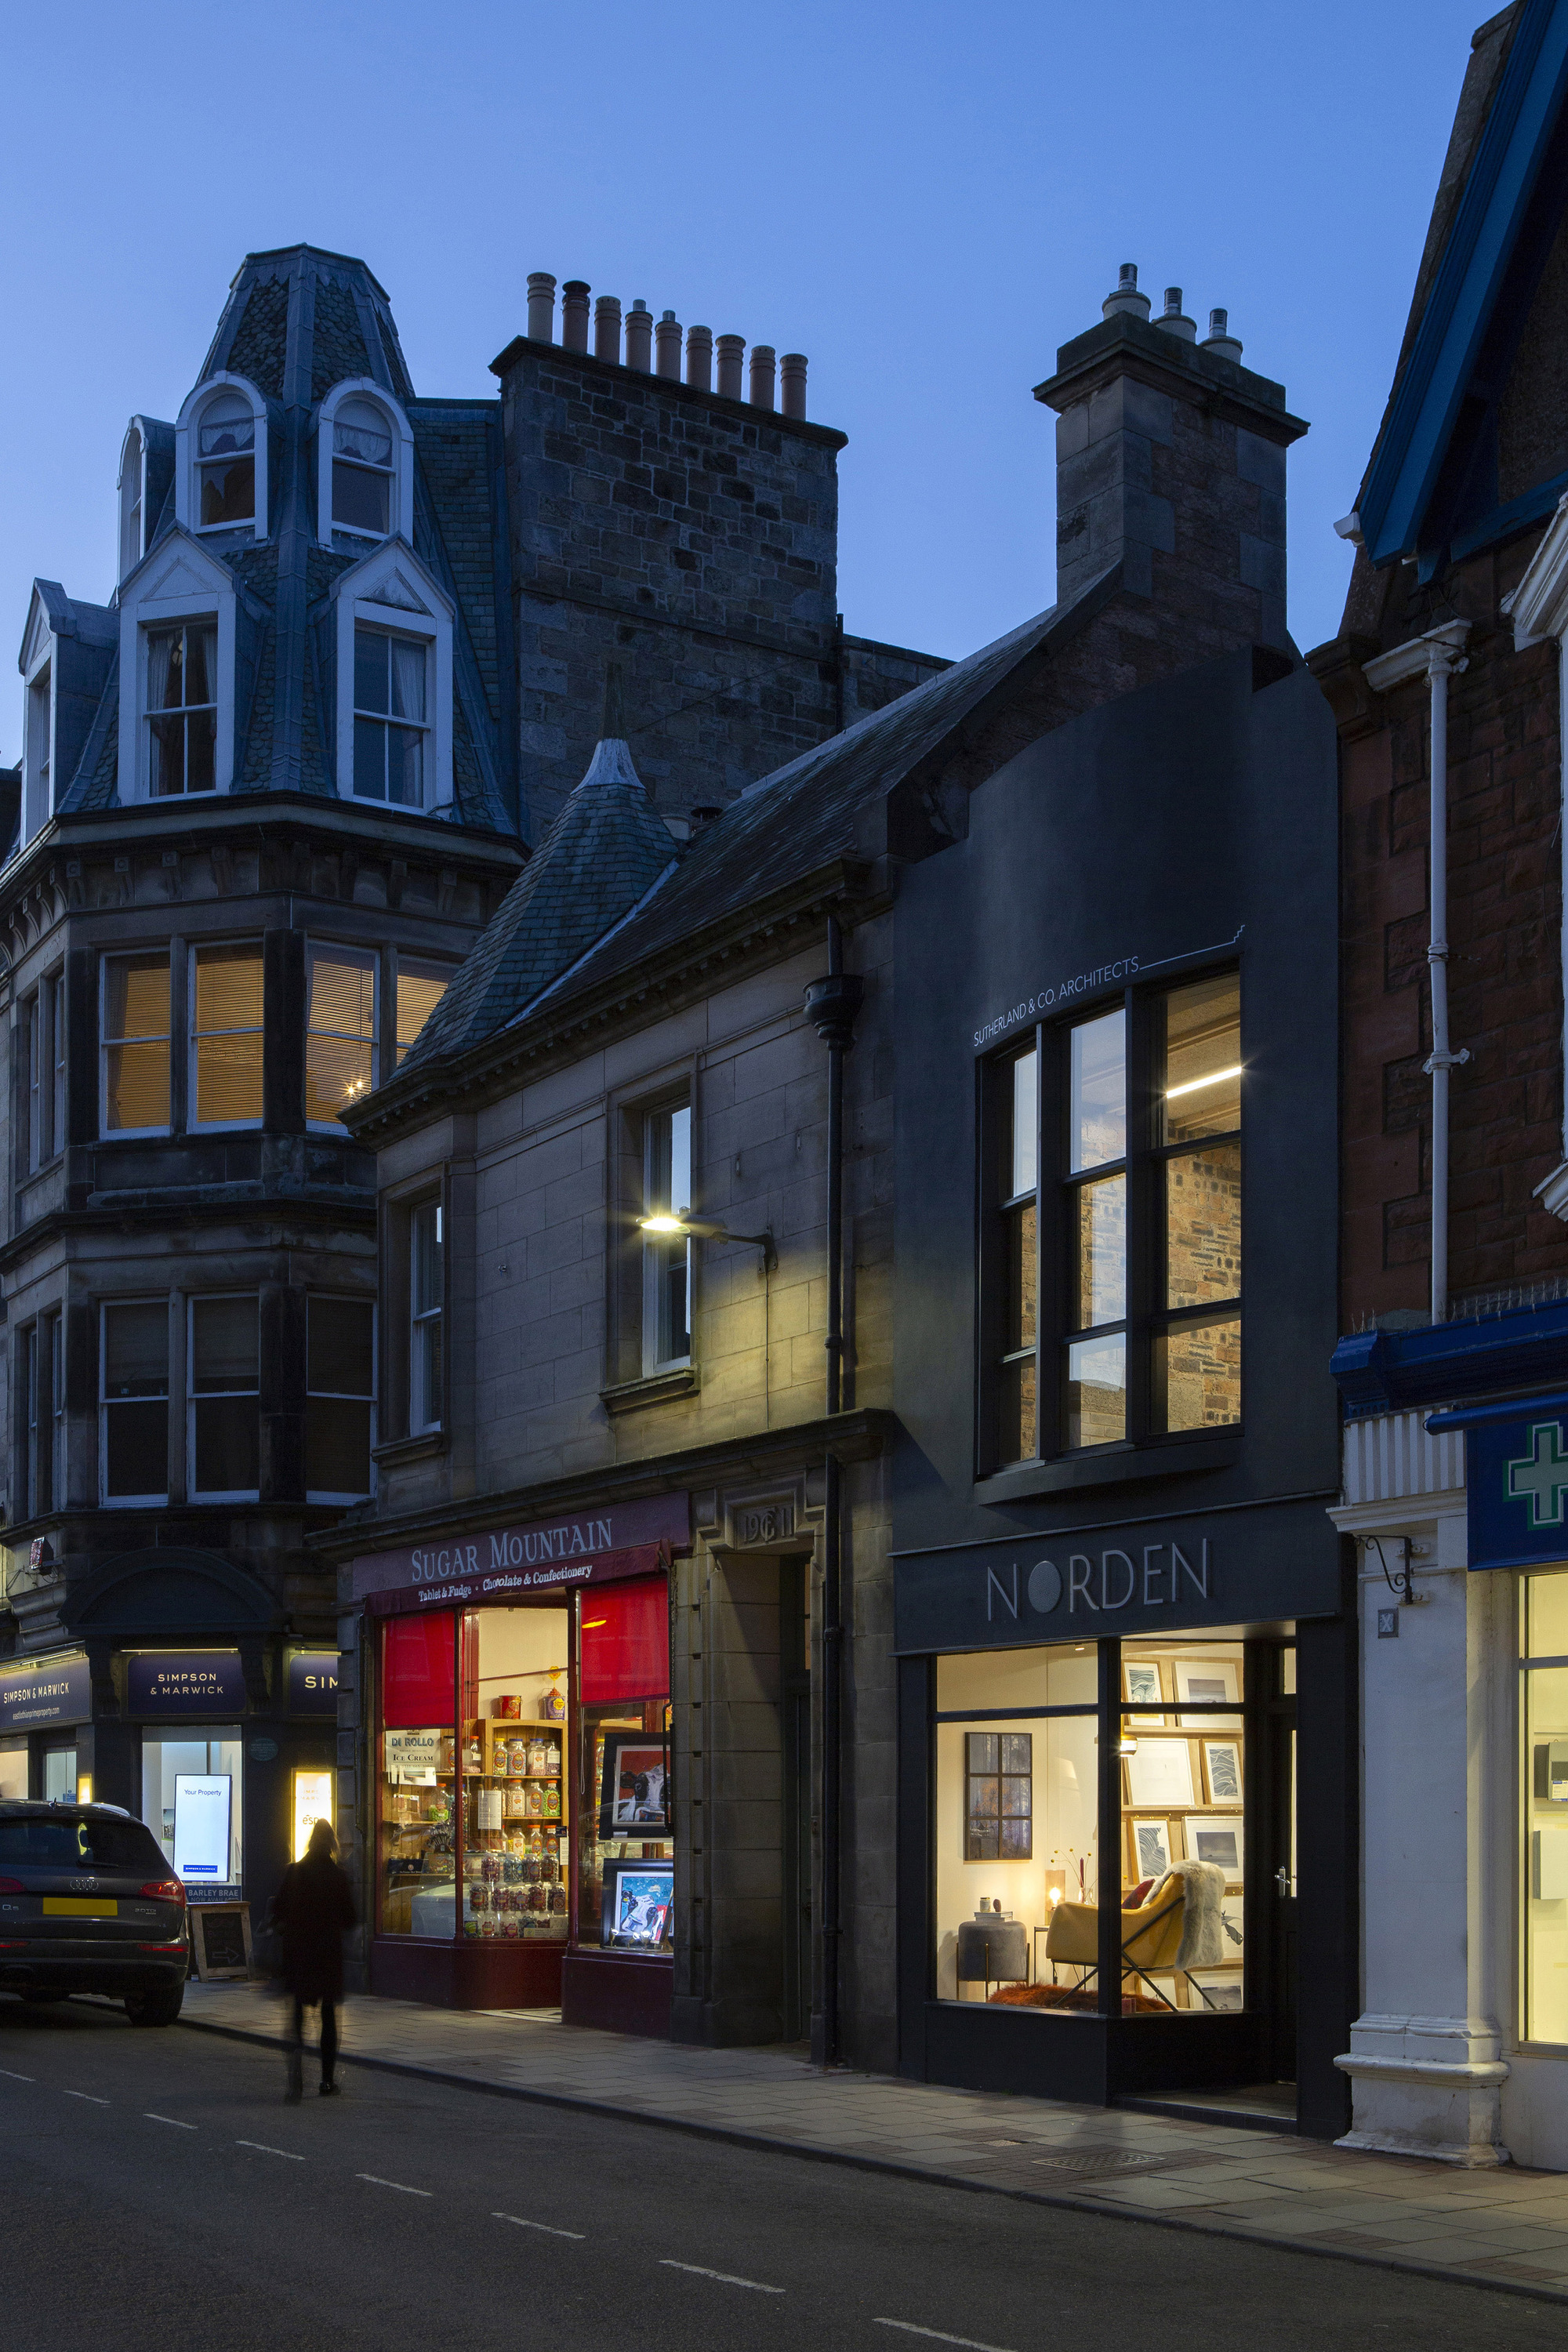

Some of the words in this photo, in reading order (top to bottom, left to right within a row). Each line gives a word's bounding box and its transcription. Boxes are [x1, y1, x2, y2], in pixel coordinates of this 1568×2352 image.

[974, 1003, 1026, 1047] SUTHERLAND
[1028, 998, 1036, 1014] &
[1037, 989, 1056, 1009] CO.
[1058, 956, 1139, 1000] ARCHITECTS
[412, 1544, 480, 1582] SUGAR
[488, 1518, 612, 1569] MOUNTAIN
[419, 1587, 441, 1602] Tablet
[441, 1587, 448, 1597] &
[448, 1584, 472, 1599] Fudge
[483, 1574, 522, 1592] Chocolate
[523, 1573, 532, 1584] &
[532, 1565, 593, 1584] Confectionery
[988, 1538, 1207, 1621] NORDEN
[158, 1673, 216, 1682] SIMPSON
[162, 1686, 223, 1695] MARWICK
[3, 1689, 31, 1704] SIMPSON
[32, 1687, 36, 1699] &
[38, 1682, 69, 1697] MARWICK
[391, 1737, 401, 1747] DI
[405, 1737, 434, 1747] ROLLO
